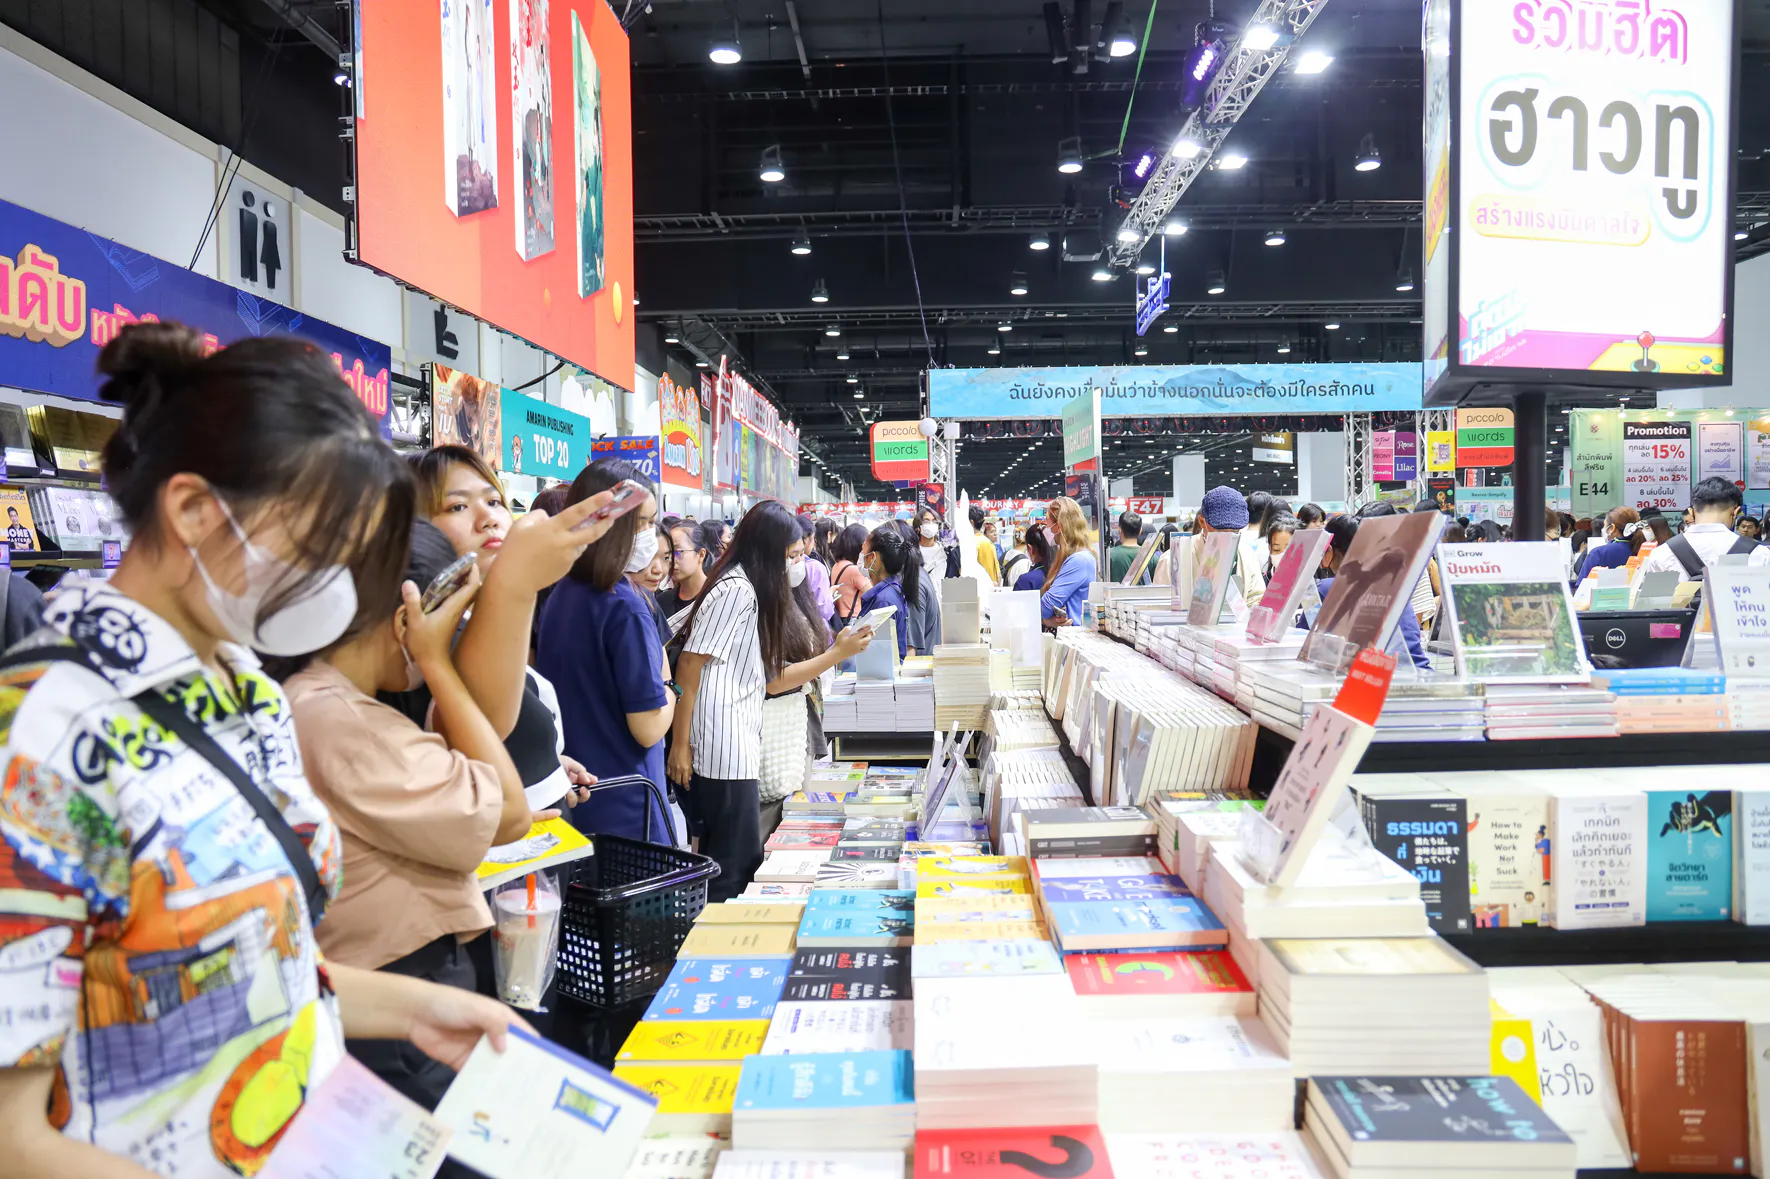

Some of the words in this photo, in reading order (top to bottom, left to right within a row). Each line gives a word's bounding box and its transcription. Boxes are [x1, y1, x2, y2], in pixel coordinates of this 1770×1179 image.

[1488, 87, 1700, 219] ฮาวทู
[526, 410, 547, 429] AMARIN
[547, 415, 574, 436] PUBLISHING
[1466, 413, 1504, 425] piccolo
[882, 425, 917, 437] piccolo
[1627, 426, 1687, 436] Promotion
[620, 439, 655, 450] SALE
[1396, 440, 1415, 450] Rose
[1629, 443, 1650, 452] ทุกเล่ม
[533, 433, 555, 465] TOP
[557, 440, 569, 469] 20
[1576, 452, 1613, 462] สำนักพิมพ์
[1652, 444, 1685, 459] 15%
[1396, 463, 1415, 472] Lilac
[1638, 475, 1656, 483] 20%
[1671, 474, 1689, 482] 25%
[1579, 482, 1609, 496] E44
[1646, 486, 1675, 496] เล่มขึ้นไป
[1637, 500, 1651, 508] ลด
[1653, 498, 1677, 508] 30%
[1447, 561, 1502, 577] ปุ๋ยหมัก
[1731, 584, 1752, 598] พูด
[1734, 600, 1766, 613] ให้คน
[1737, 616, 1767, 627] เข้าใจ
[1491, 821, 1511, 829] How
[1512, 821, 1523, 829] to
[1583, 815, 1621, 828] เทคนิค
[1386, 821, 1459, 836] ธรรมดา
[1494, 832, 1519, 840] Make
[1572, 830, 1633, 843] เลิกคิดเยอะ
[1396, 842, 1408, 860] ที่
[1572, 844, 1632, 857] แล้วทำทันที
[1499, 855, 1515, 863] Not
[1496, 867, 1518, 875] Suck
[1540, 1063, 1594, 1096] หัวใจ
